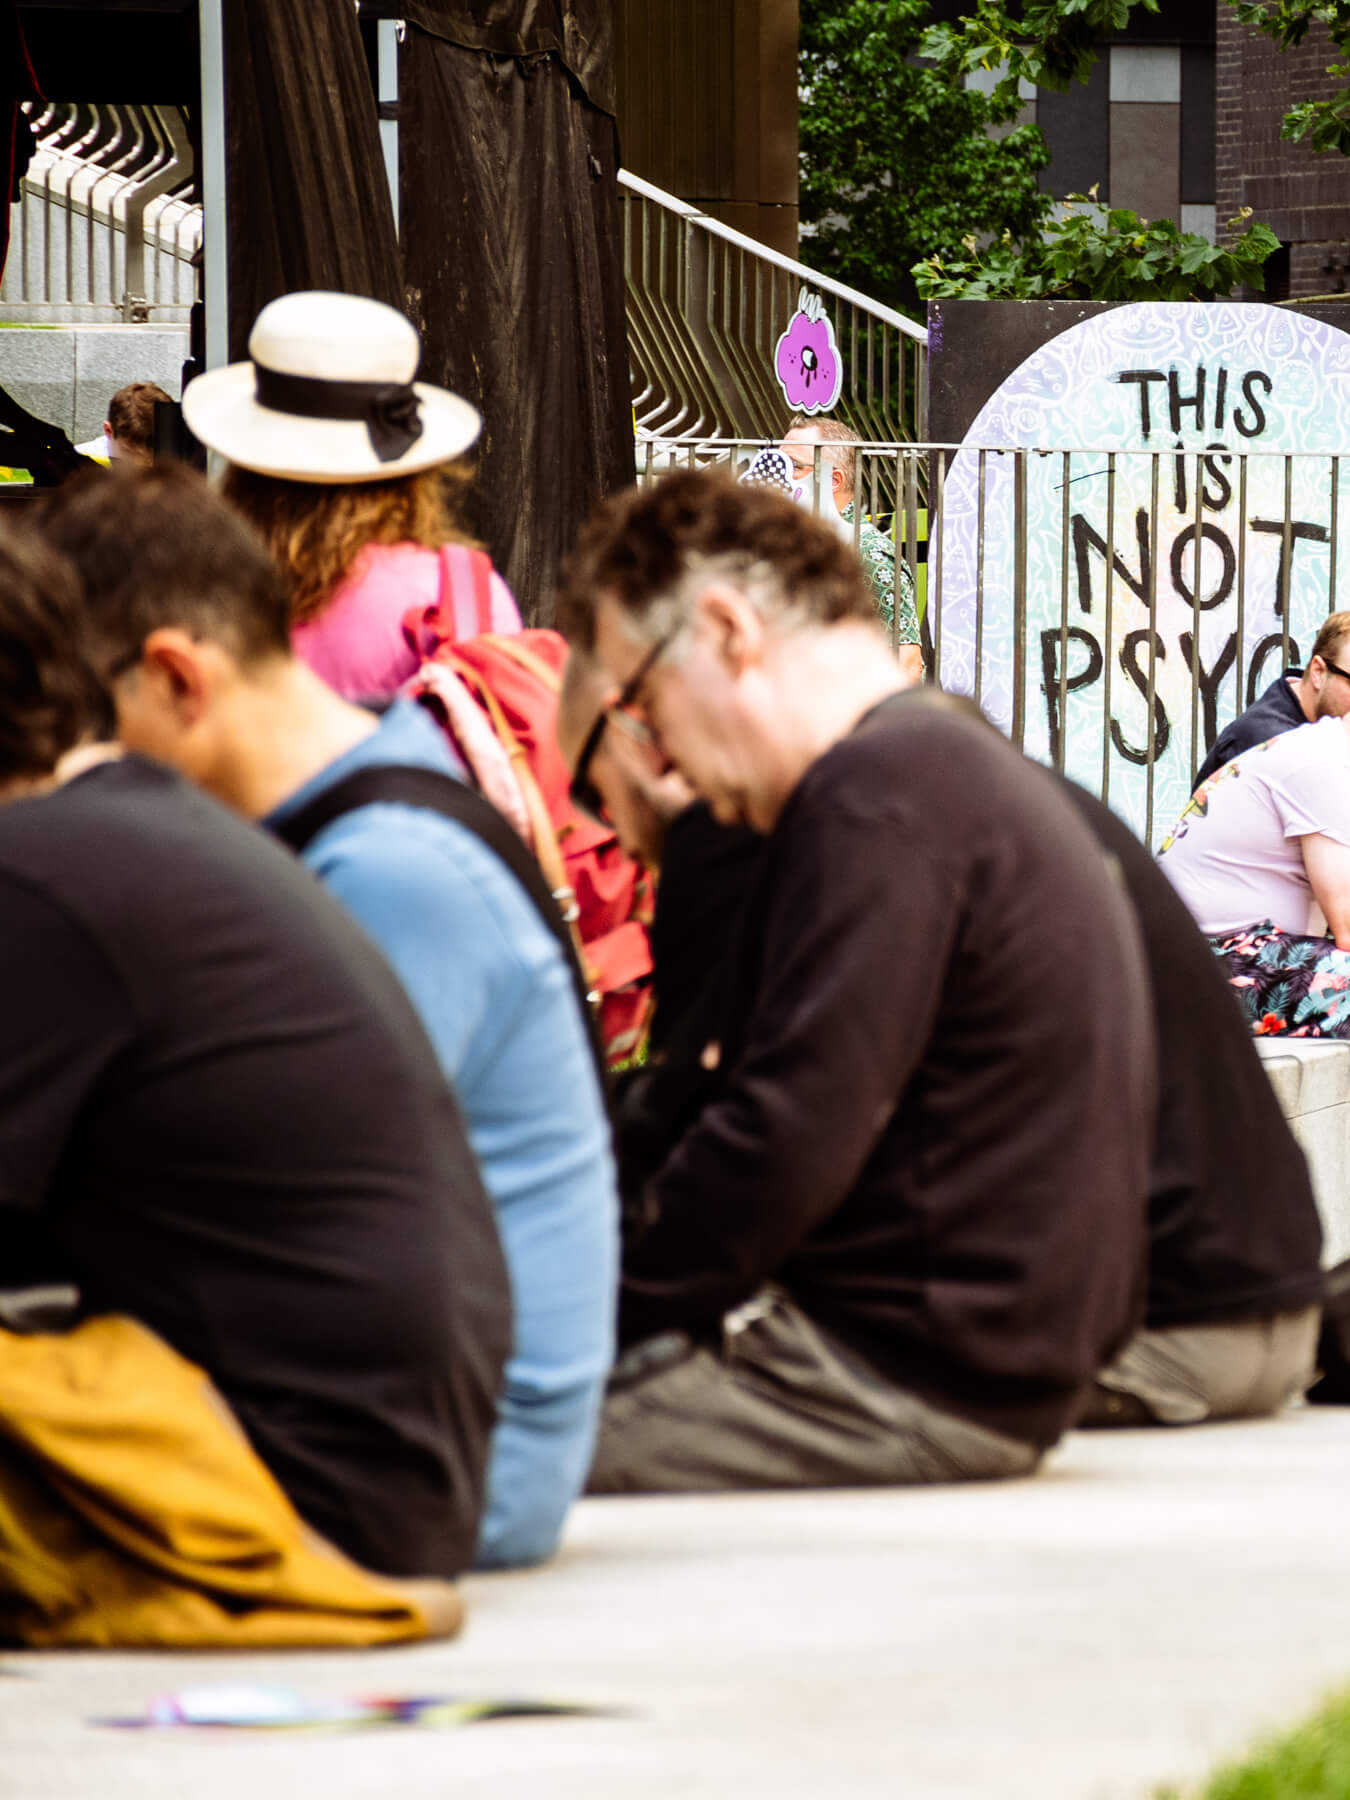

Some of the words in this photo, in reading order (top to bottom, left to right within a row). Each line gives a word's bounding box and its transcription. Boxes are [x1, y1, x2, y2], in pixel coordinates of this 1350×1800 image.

[1114, 363, 1272, 440] THIS
[1174, 441, 1232, 514] IS
[1071, 506, 1331, 617] NOT
